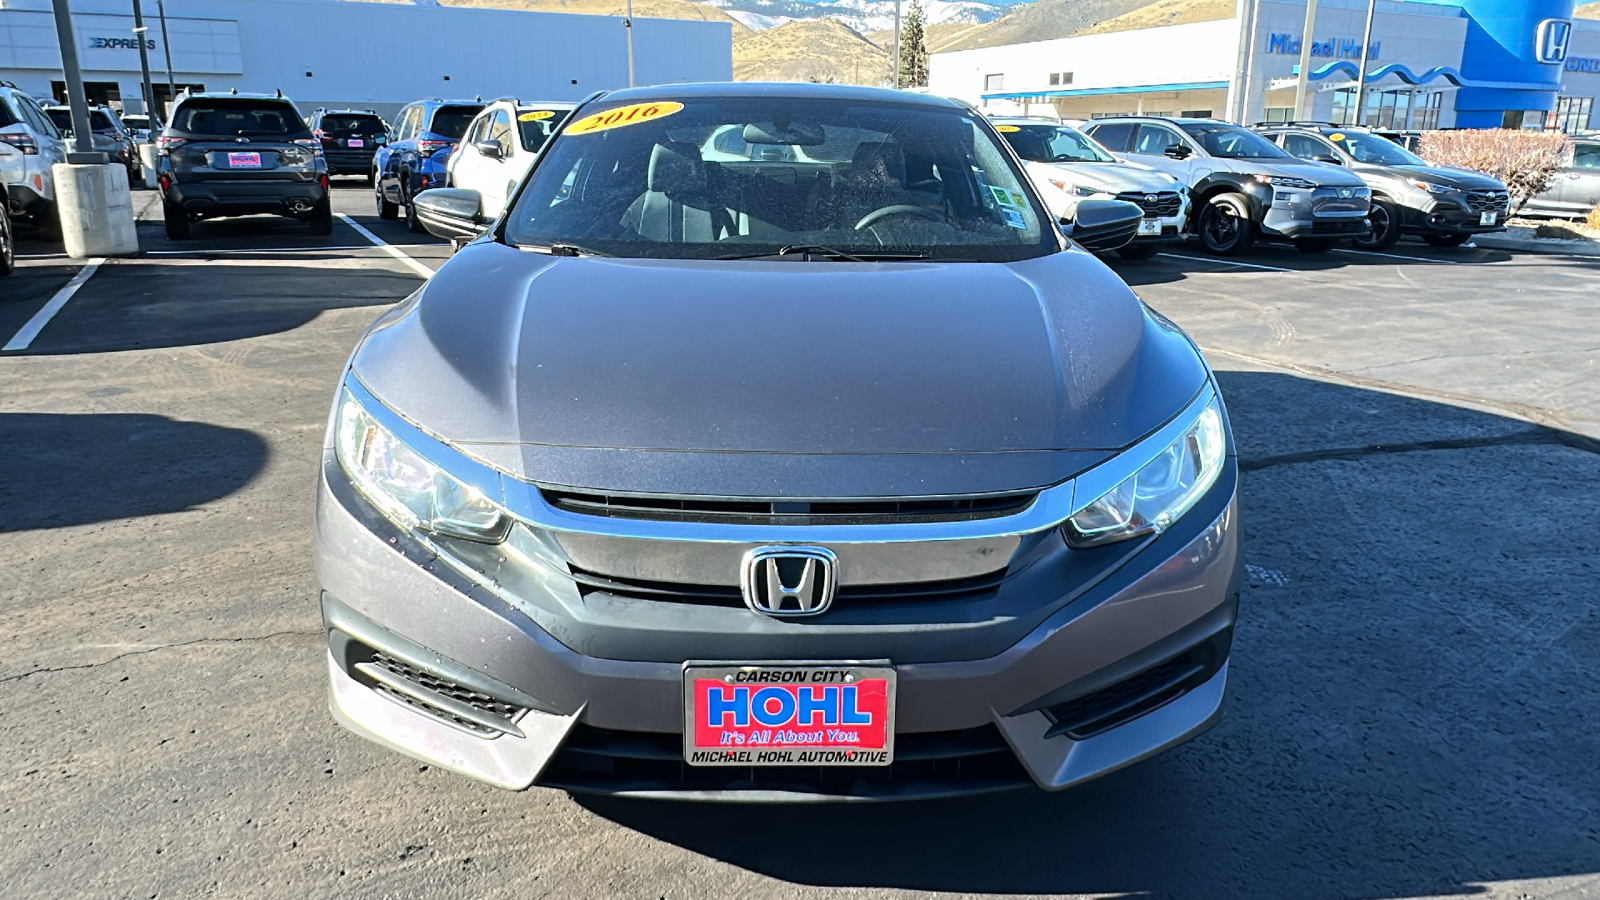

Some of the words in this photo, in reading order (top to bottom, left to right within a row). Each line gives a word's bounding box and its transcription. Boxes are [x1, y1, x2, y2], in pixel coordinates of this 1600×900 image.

[88, 37, 156, 50] EXPRES
[1269, 33, 1336, 57] Micael
[584, 104, 660, 131] 2016
[736, 671, 807, 682] CARSON
[811, 671, 850, 682] CITY
[708, 686, 872, 727] HOHL
[720, 730, 746, 744] It's
[747, 730, 771, 744] All
[772, 729, 823, 744] About
[826, 729, 860, 743] You.
[691, 751, 752, 762] MICHAEL
[757, 751, 793, 762] HOHL
[797, 751, 888, 762] AUTOMOTIVE
